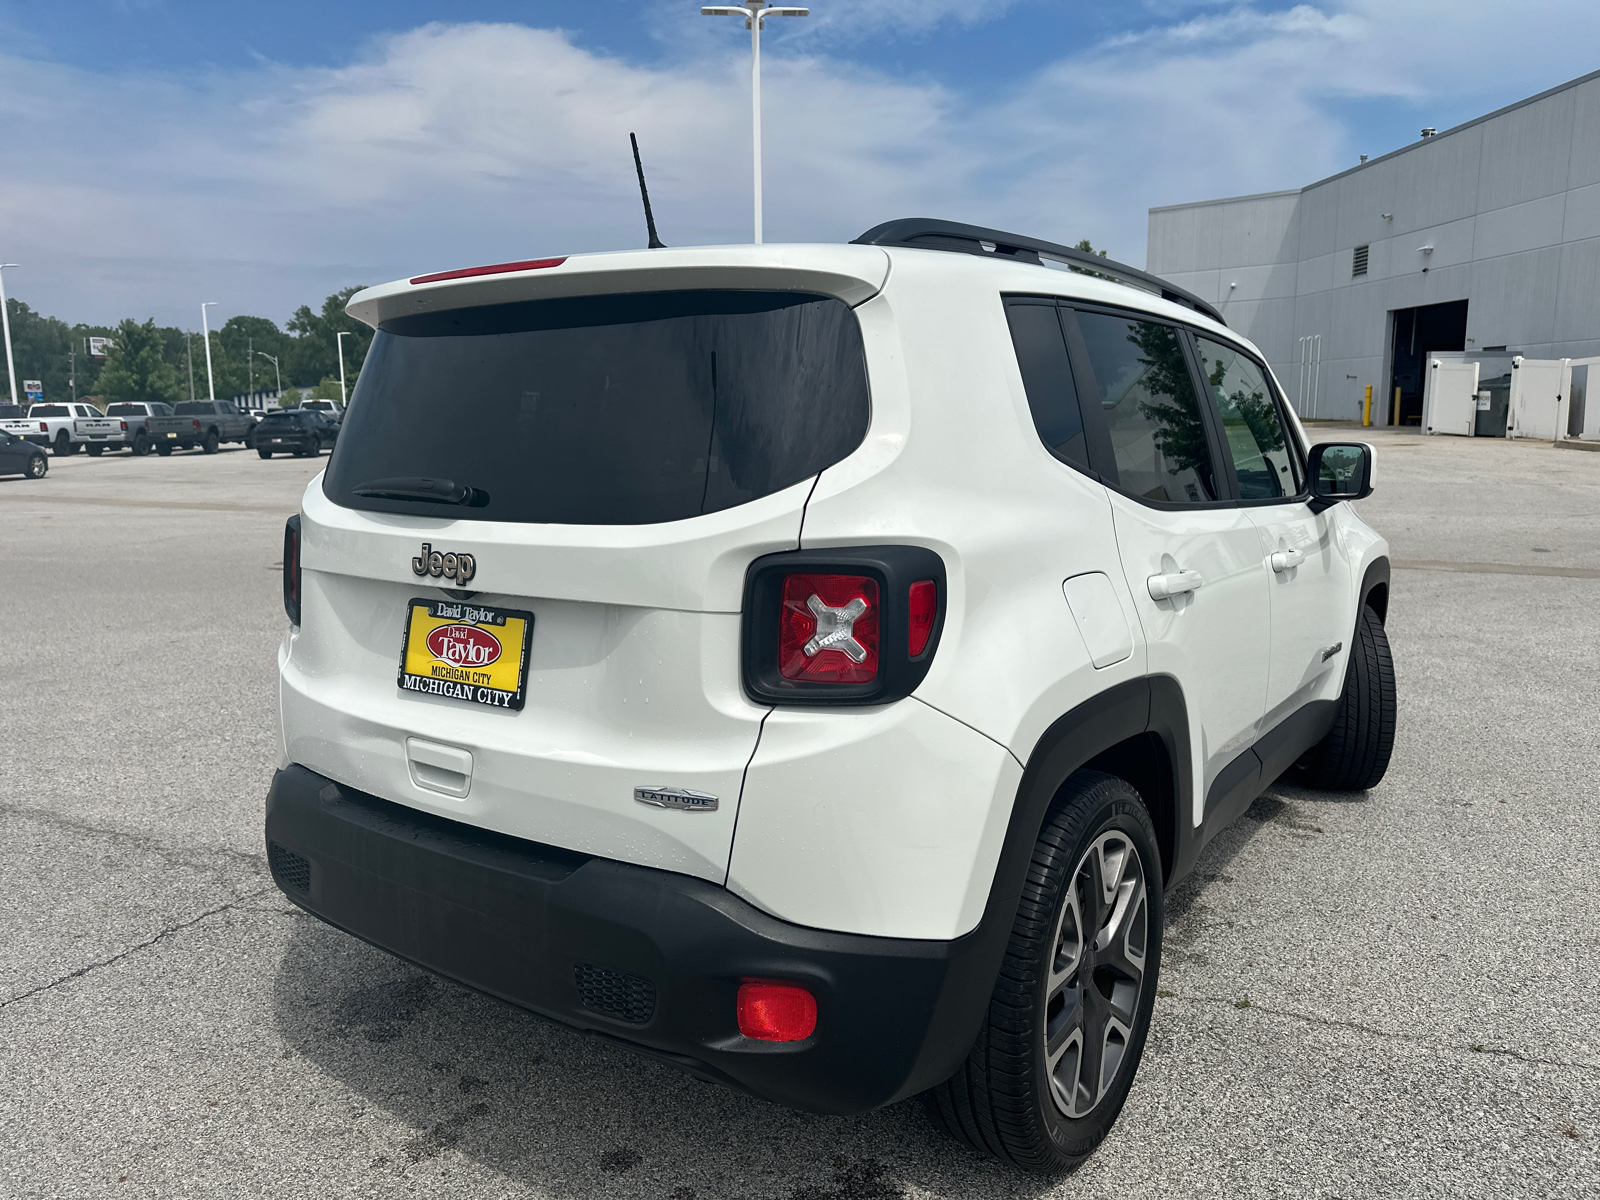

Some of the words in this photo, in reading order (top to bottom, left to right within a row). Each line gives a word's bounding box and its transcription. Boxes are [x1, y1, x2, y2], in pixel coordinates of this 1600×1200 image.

[412, 543, 476, 586] Jeep
[437, 602, 462, 619] David
[461, 606, 495, 624] Taylor
[447, 627, 468, 639] David
[436, 636, 493, 667] Taylor
[431, 666, 470, 682] MICHIGAN
[472, 672, 492, 686] CITY
[403, 674, 475, 700] MICHIGAN
[477, 688, 513, 708] CITY
[642, 792, 709, 806] LATITUDE
